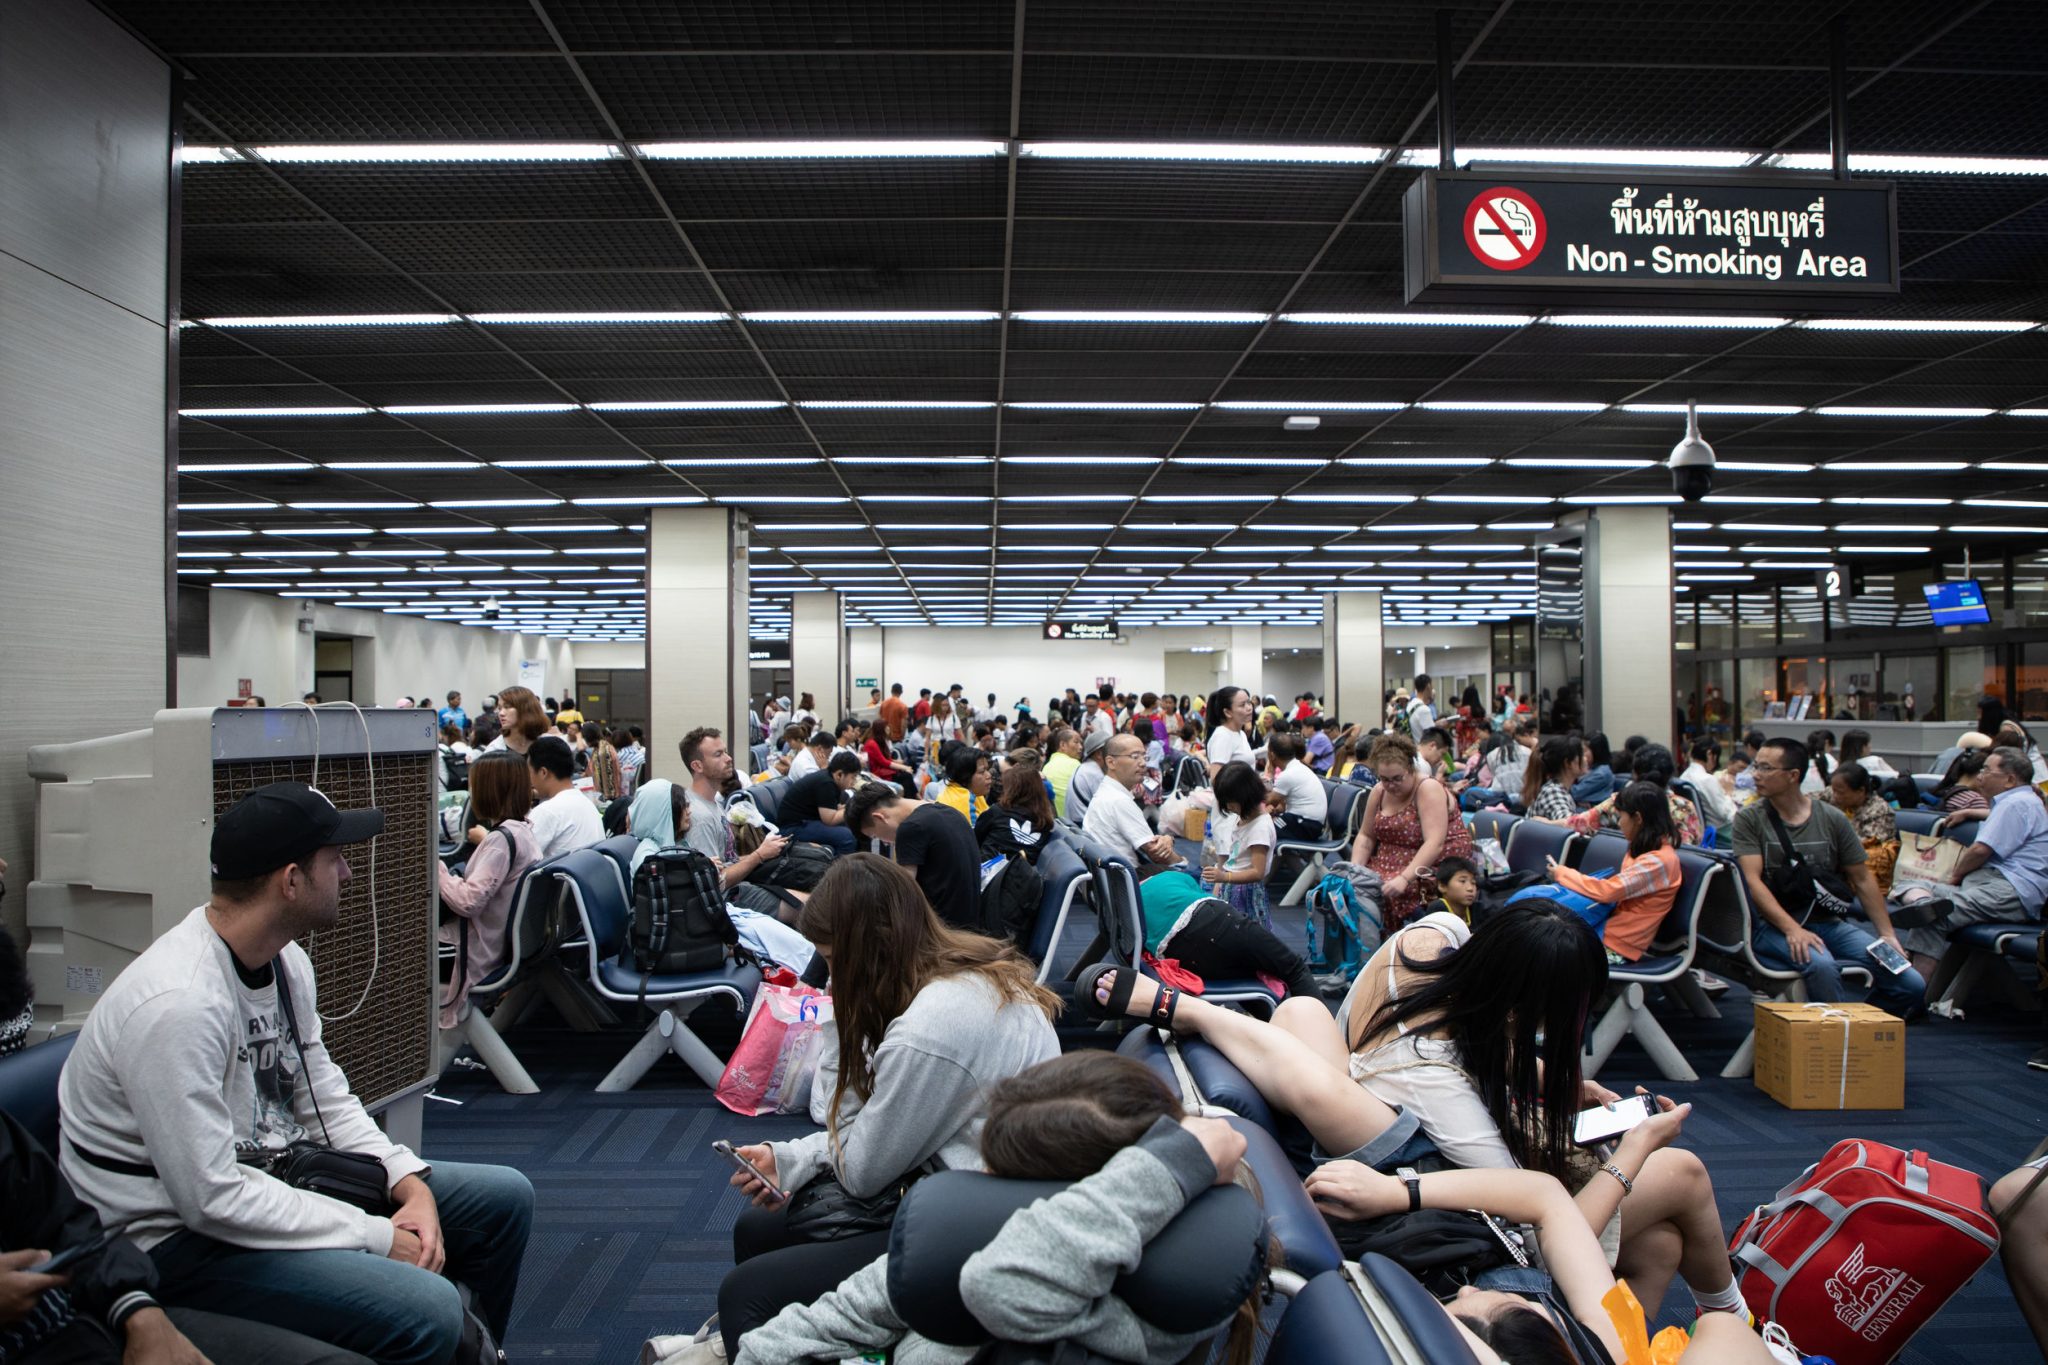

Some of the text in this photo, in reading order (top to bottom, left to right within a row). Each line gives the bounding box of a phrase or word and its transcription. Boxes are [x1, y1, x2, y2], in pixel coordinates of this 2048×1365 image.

[1610, 187, 1825, 247] พื้นที่ห้ามสูบบุหรี่
[1797, 249, 1867, 277] Area
[1826, 571, 1841, 597] 2
[425, 726, 431, 738] 3
[1862, 1277, 1926, 1342] GENERALI
